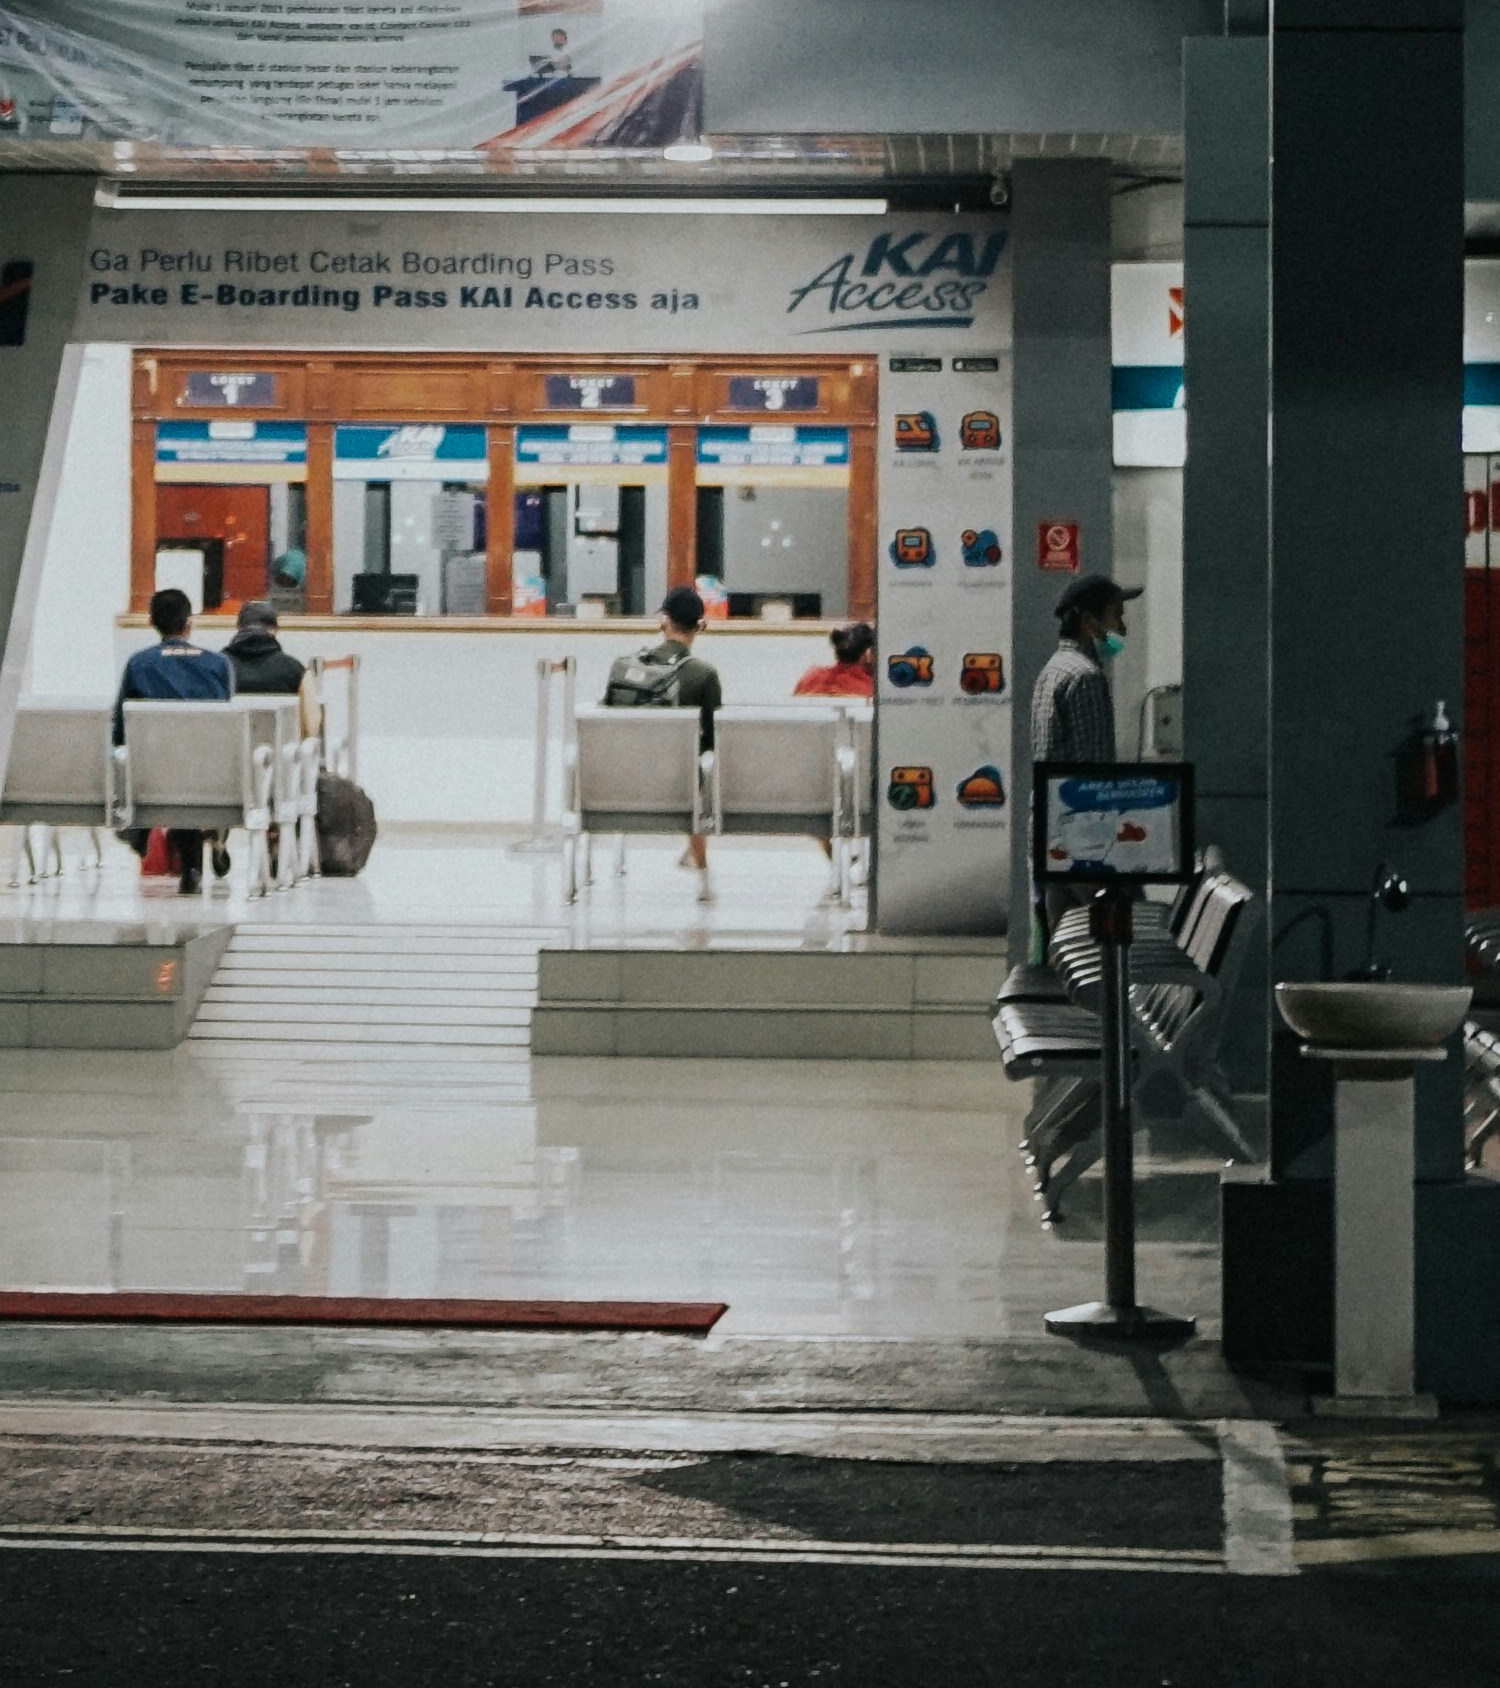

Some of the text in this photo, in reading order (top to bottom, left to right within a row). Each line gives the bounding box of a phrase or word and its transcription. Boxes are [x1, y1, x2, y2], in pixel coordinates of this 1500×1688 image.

[90, 249, 615, 280] Ga Perlu Ribet Cetak Boarding Pass
[861, 230, 1009, 278] KAI
[91, 282, 700, 315] Pake E-Boarding Pass KAI Access aja
[786, 252, 987, 314] Access
